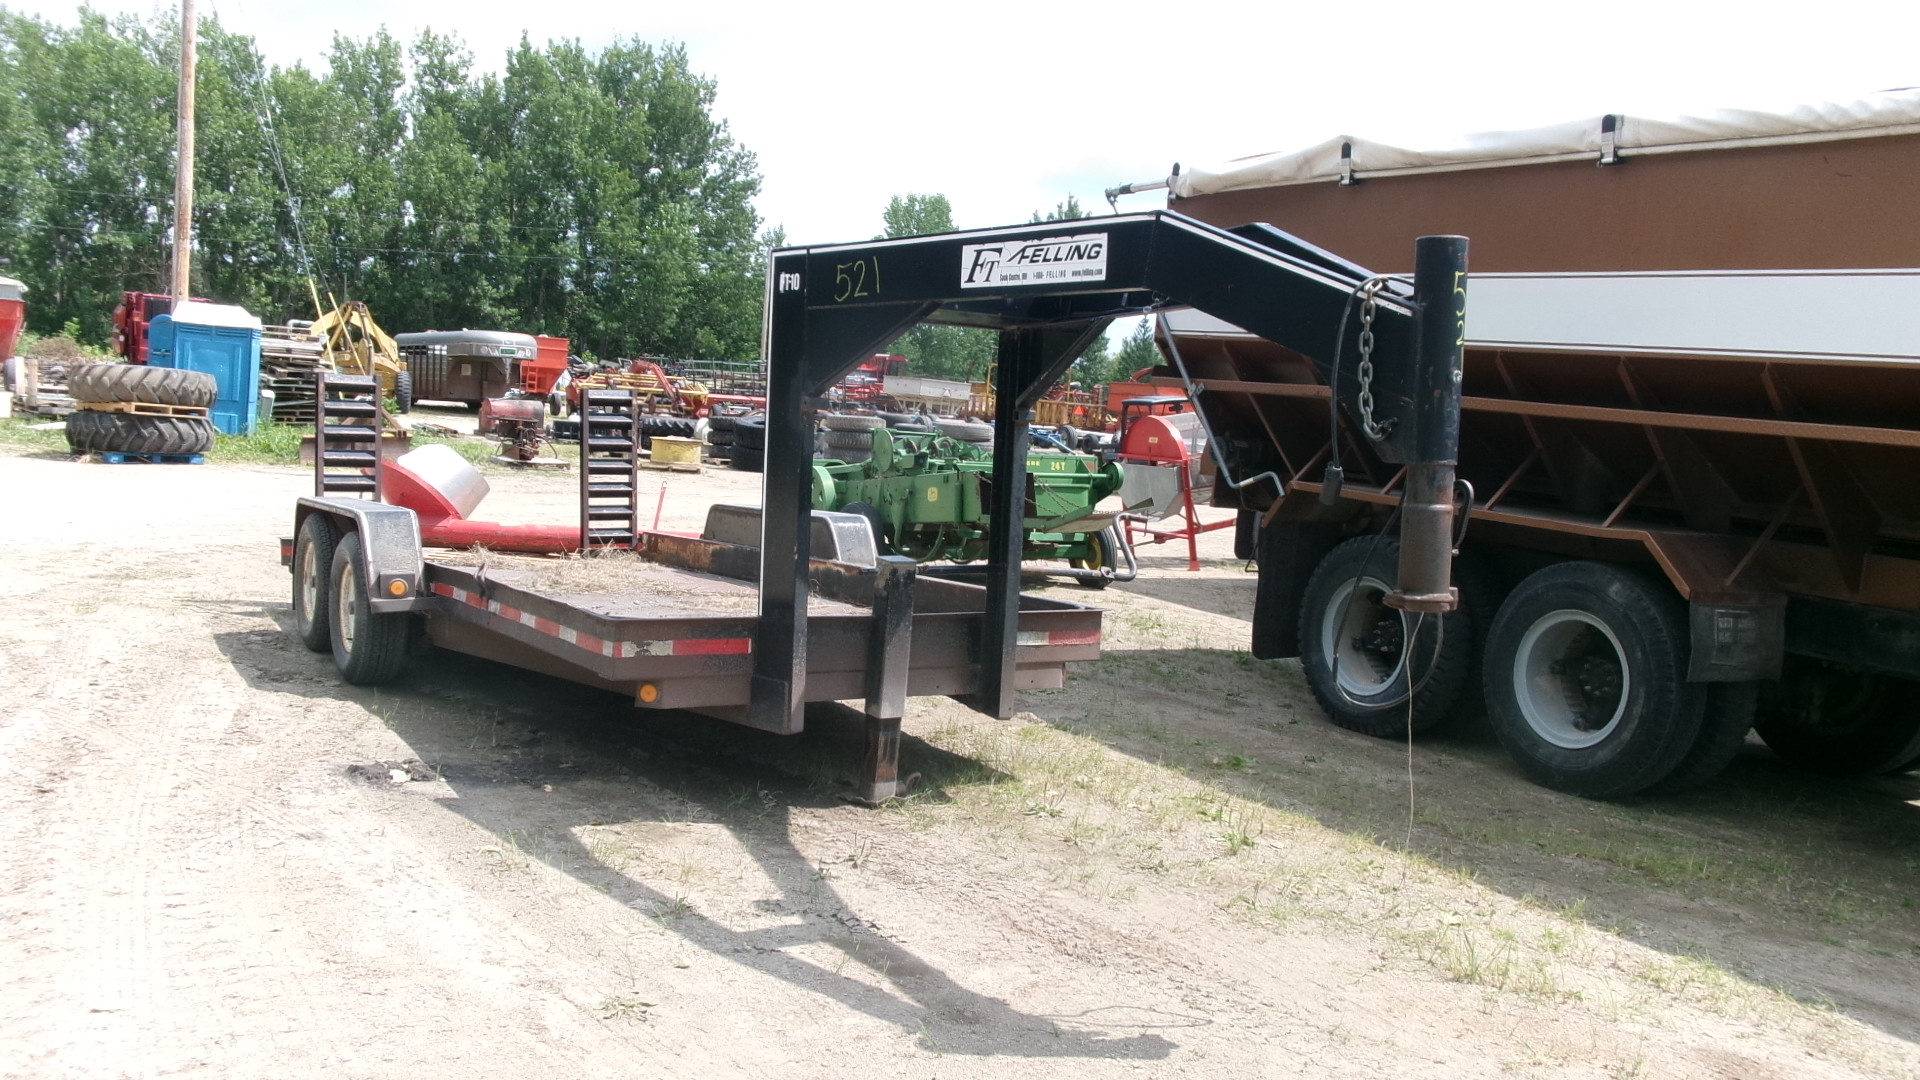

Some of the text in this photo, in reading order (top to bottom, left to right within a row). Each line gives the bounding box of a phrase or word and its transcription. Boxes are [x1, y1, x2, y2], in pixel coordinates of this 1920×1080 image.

[964, 247, 1003, 284] FT
[1008, 241, 1103, 264] FELLING
[834, 255, 881, 302] 521
